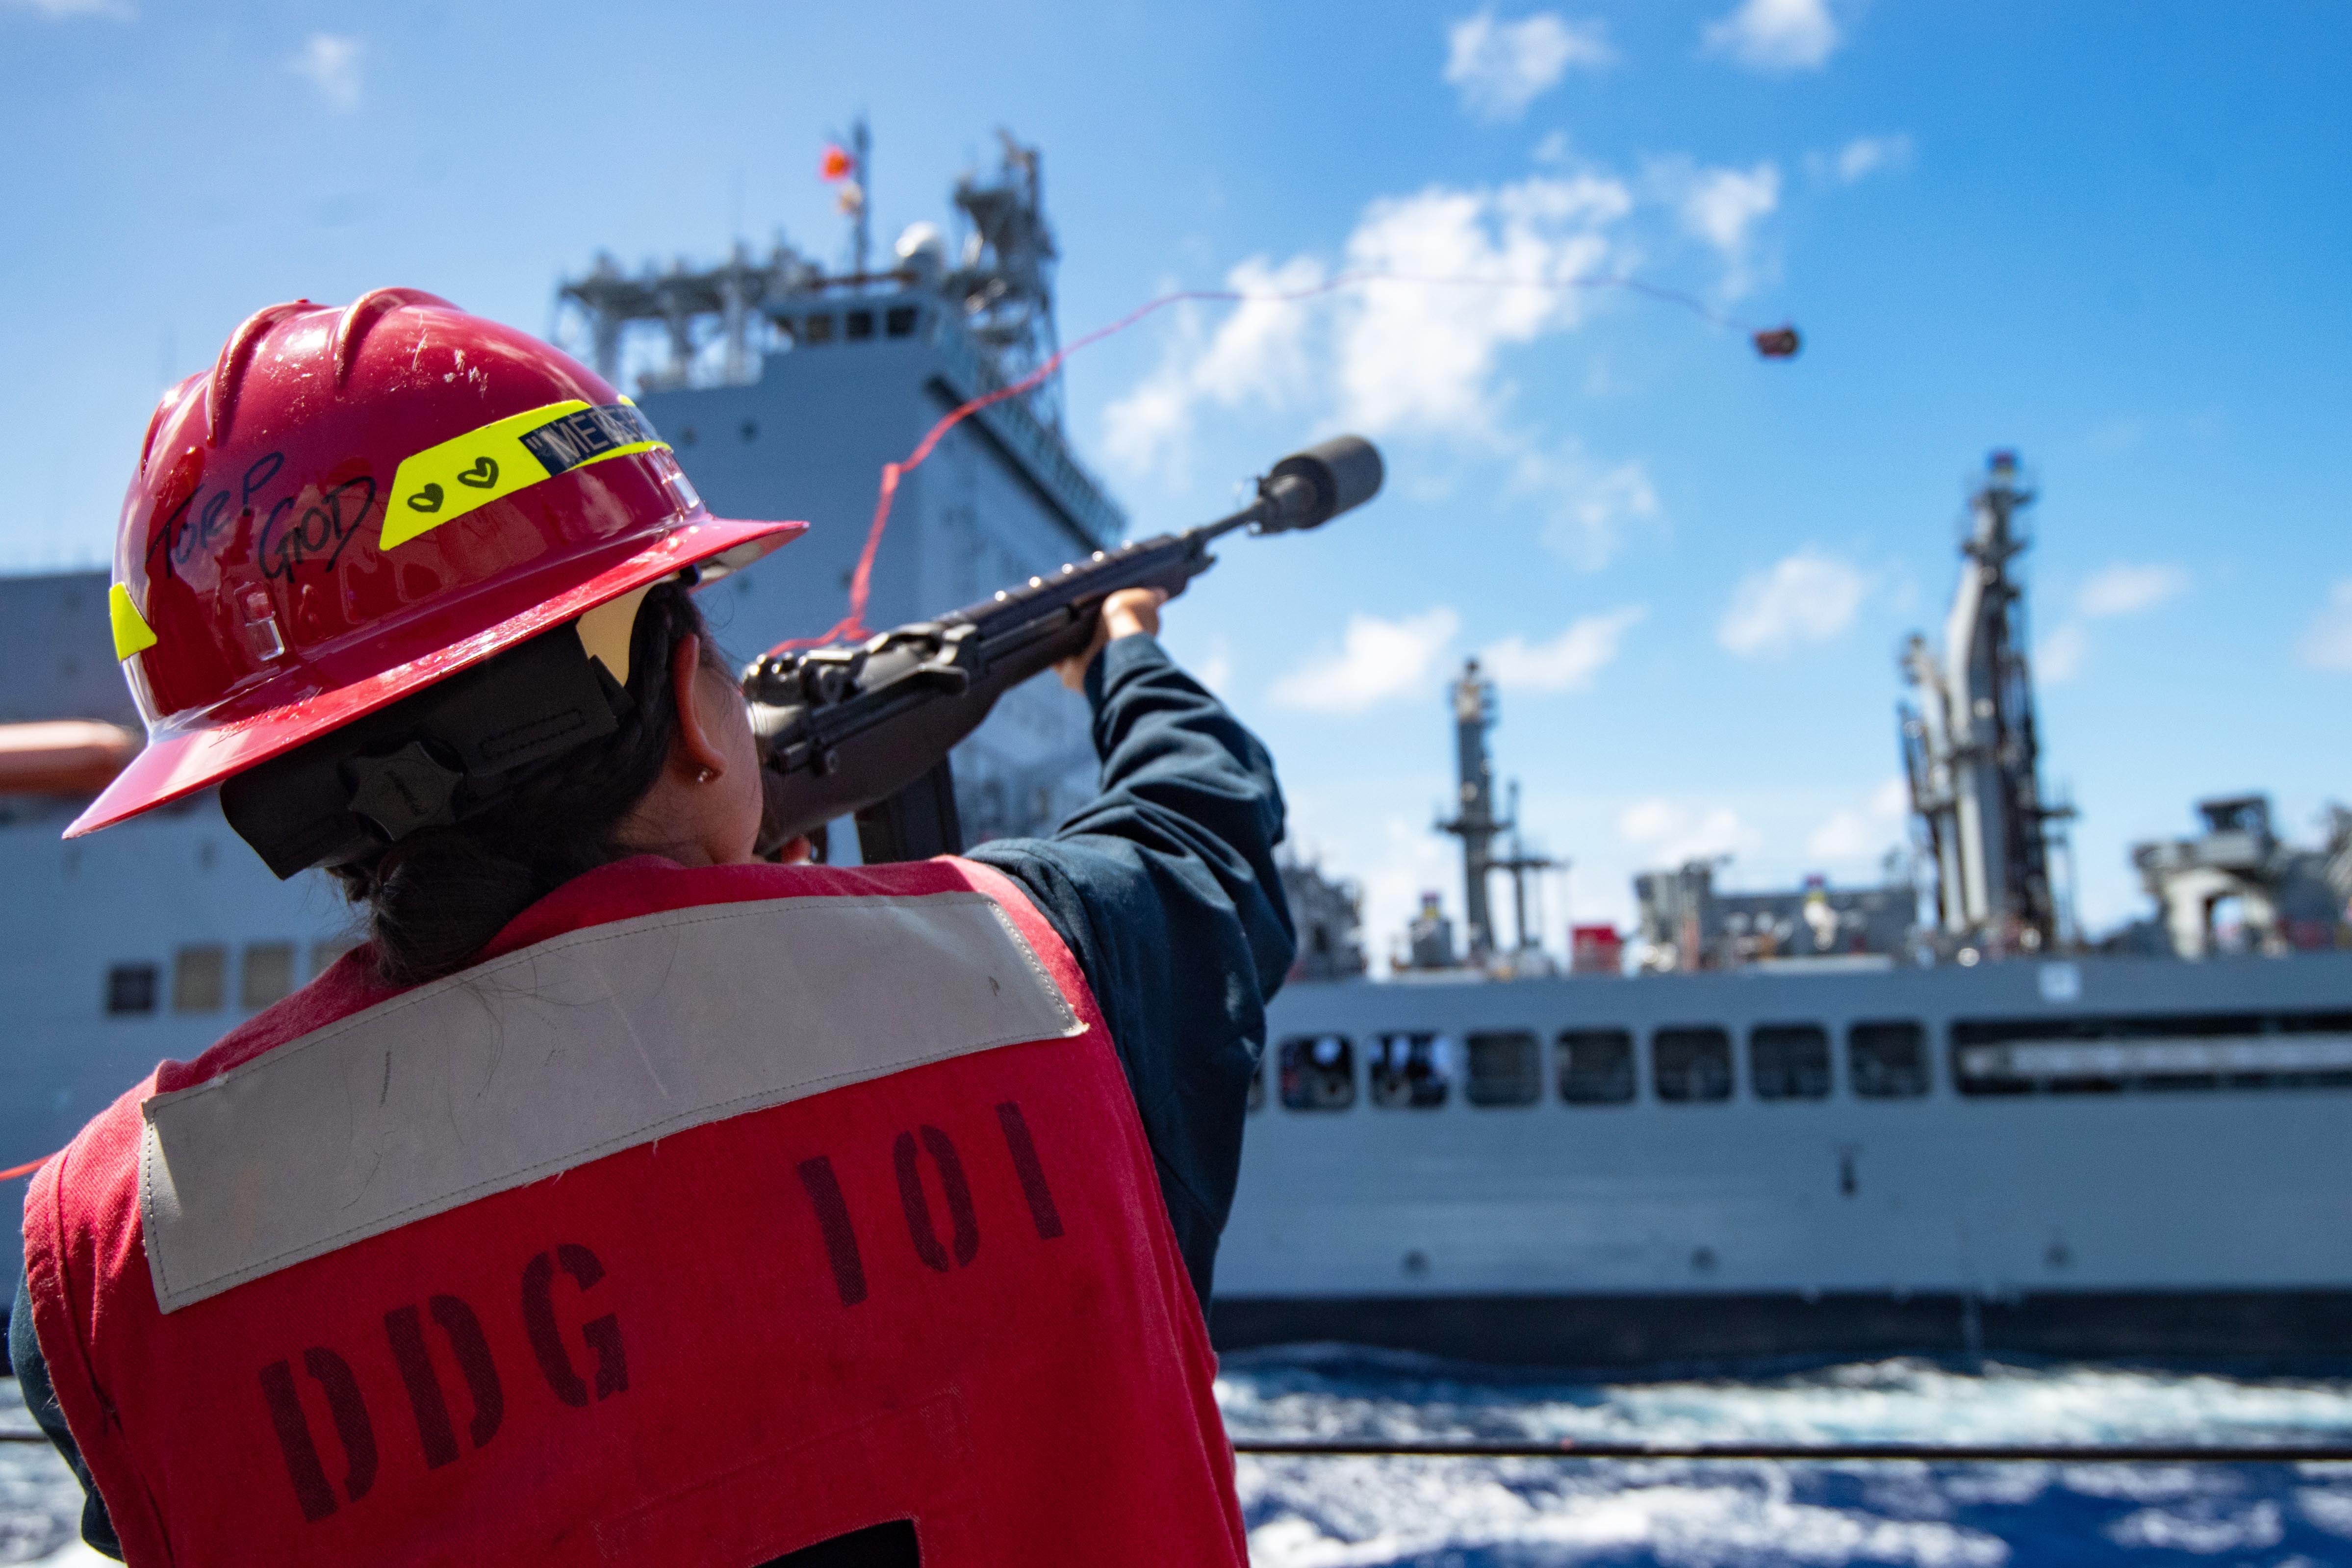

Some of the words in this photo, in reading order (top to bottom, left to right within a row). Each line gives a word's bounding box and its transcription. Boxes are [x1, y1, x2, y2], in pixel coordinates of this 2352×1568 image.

[258, 475, 377, 584] GOD
[259, 1243, 629, 1523] DDG
[796, 1100, 1065, 1308] 101
